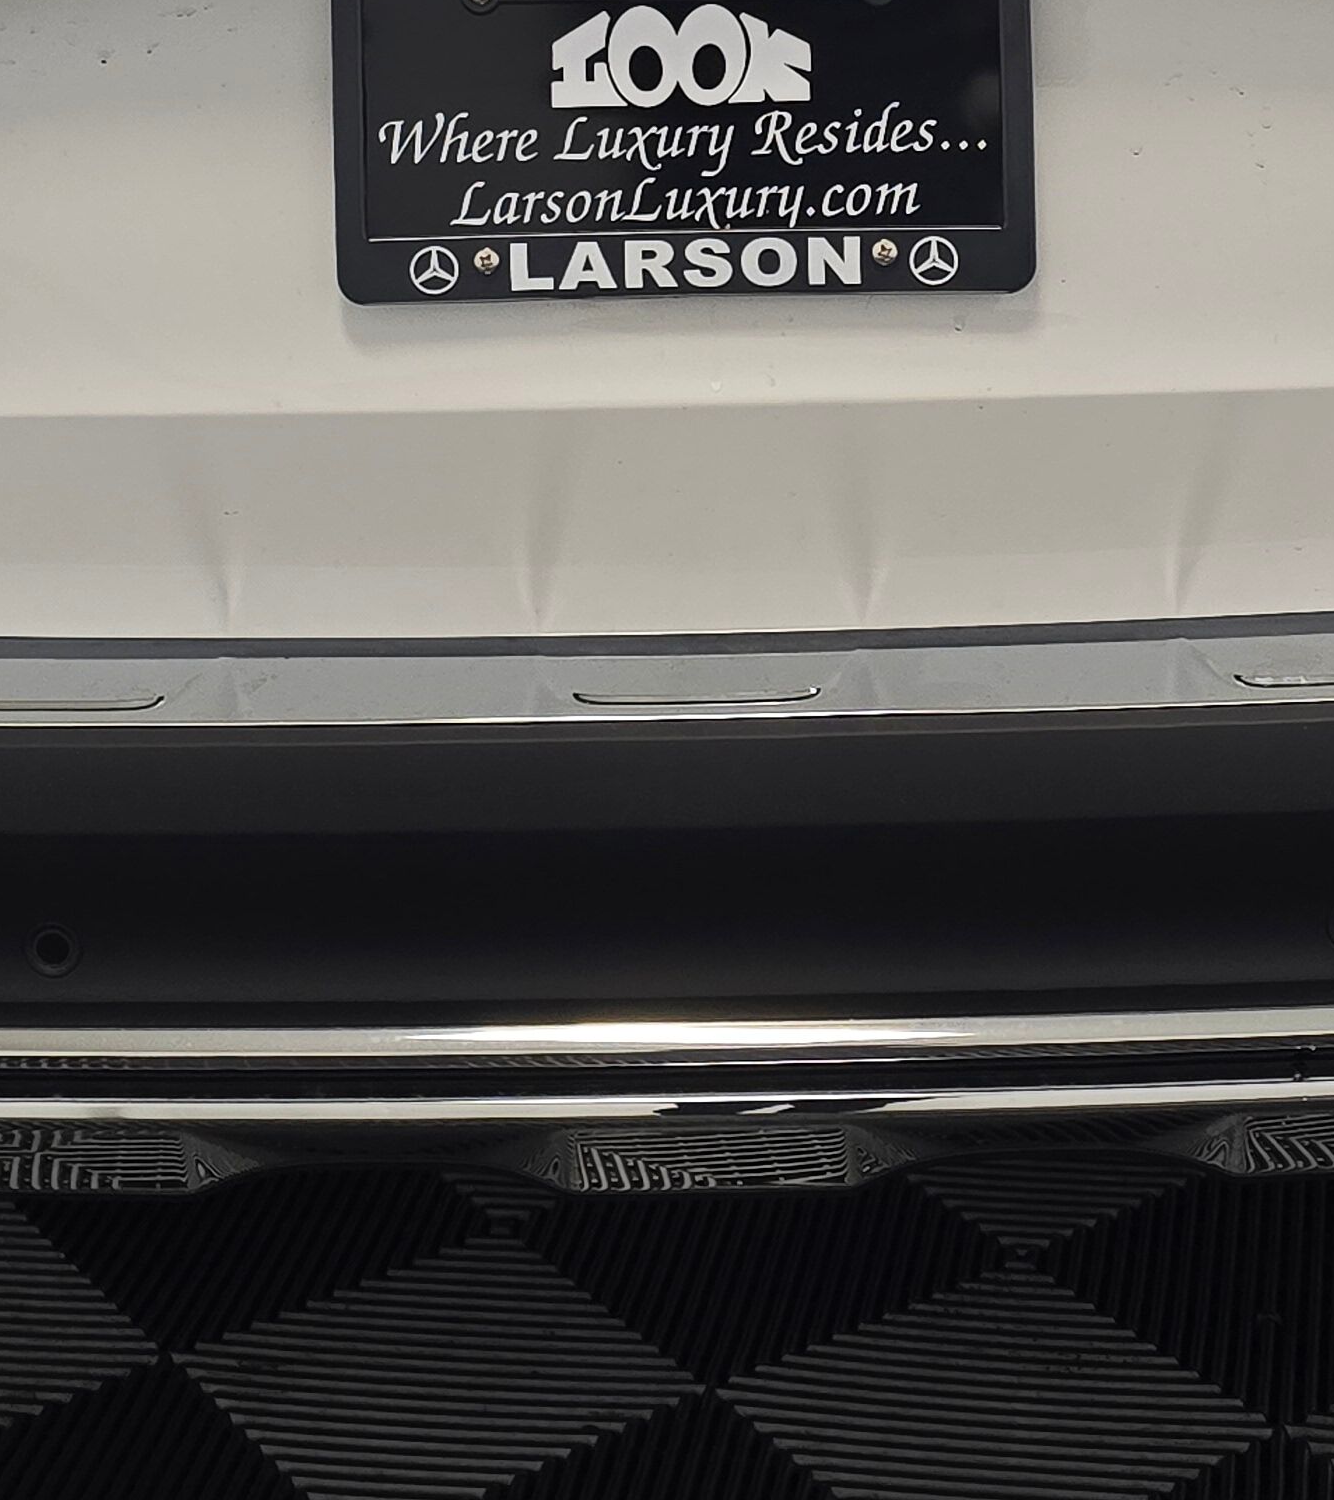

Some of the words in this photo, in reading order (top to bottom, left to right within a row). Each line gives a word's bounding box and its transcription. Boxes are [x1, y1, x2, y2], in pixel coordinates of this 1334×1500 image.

[377, 112, 539, 165] Where
[553, 116, 735, 177] Luxury
[750, 101, 988, 166] Resides...
[449, 177, 921, 230] LarsonLuxury.com
[509, 235, 862, 292] LARSON
